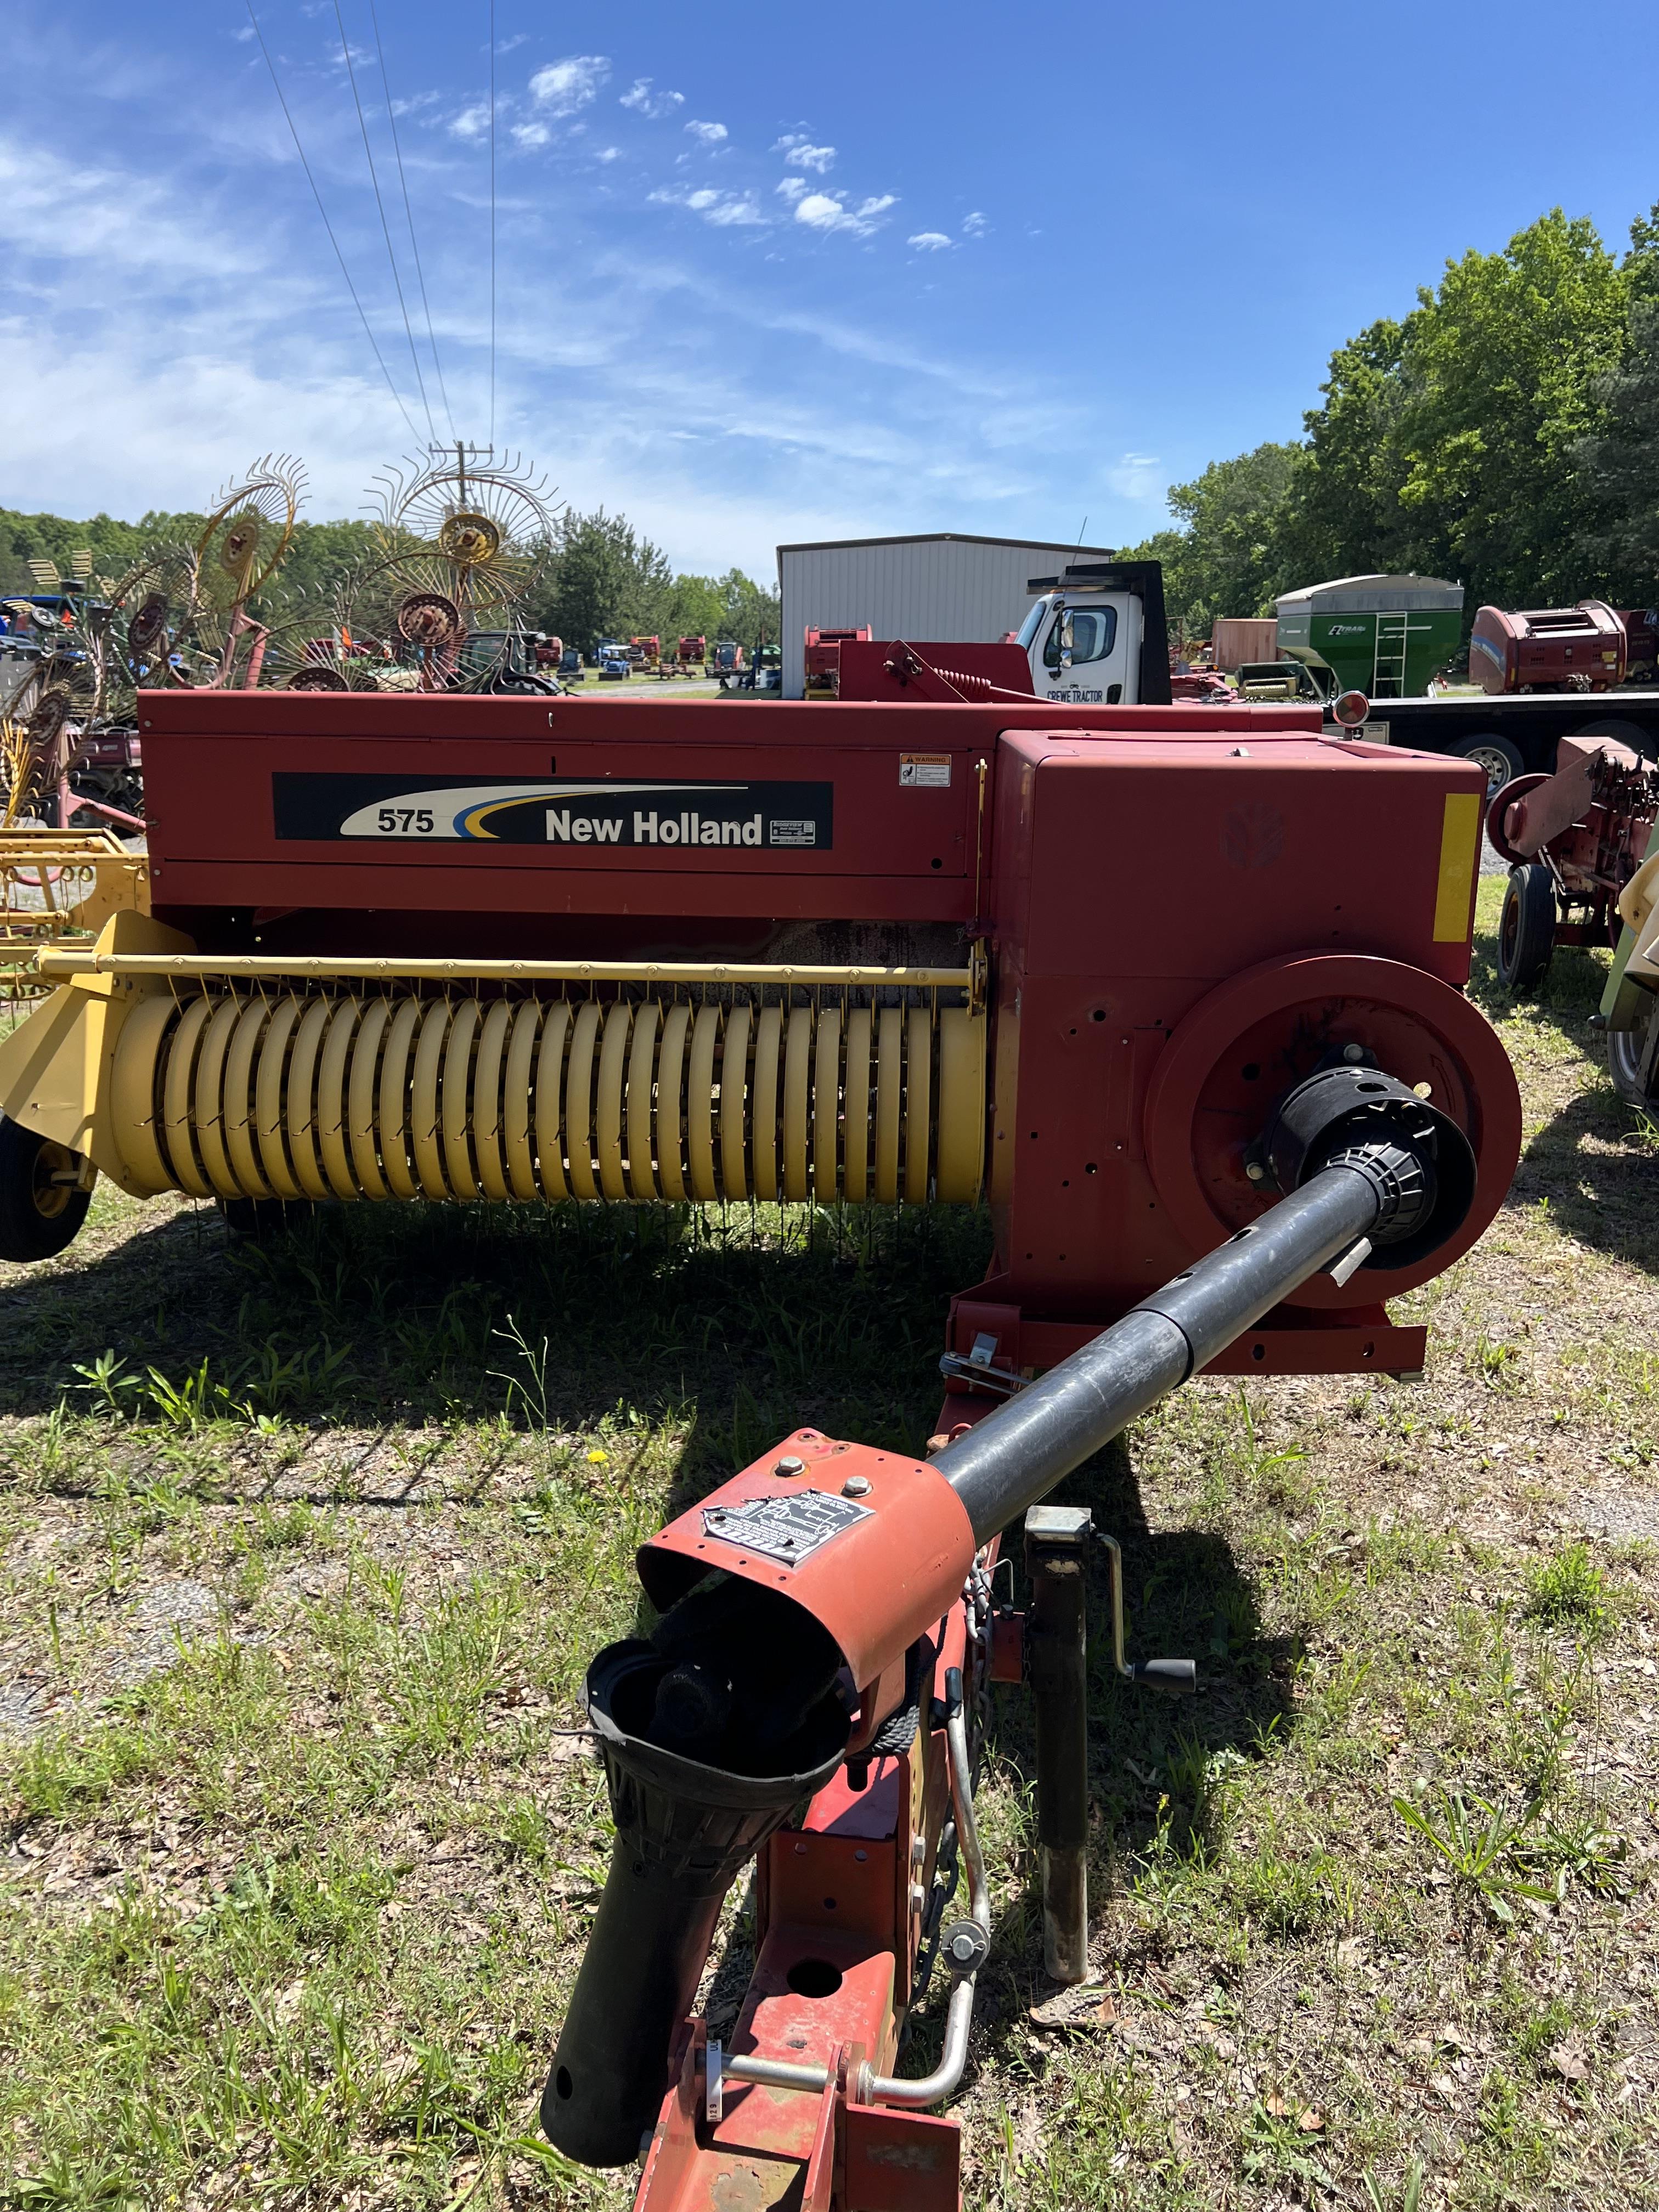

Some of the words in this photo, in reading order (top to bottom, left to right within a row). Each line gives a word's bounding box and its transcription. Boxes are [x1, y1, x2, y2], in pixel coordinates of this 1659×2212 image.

[1047, 691, 1071, 702] CREWE
[1073, 691, 1103, 702] TRACTOR
[377, 809, 434, 832] 575
[546, 810, 623, 842] New
[634, 811, 762, 845] Holland
